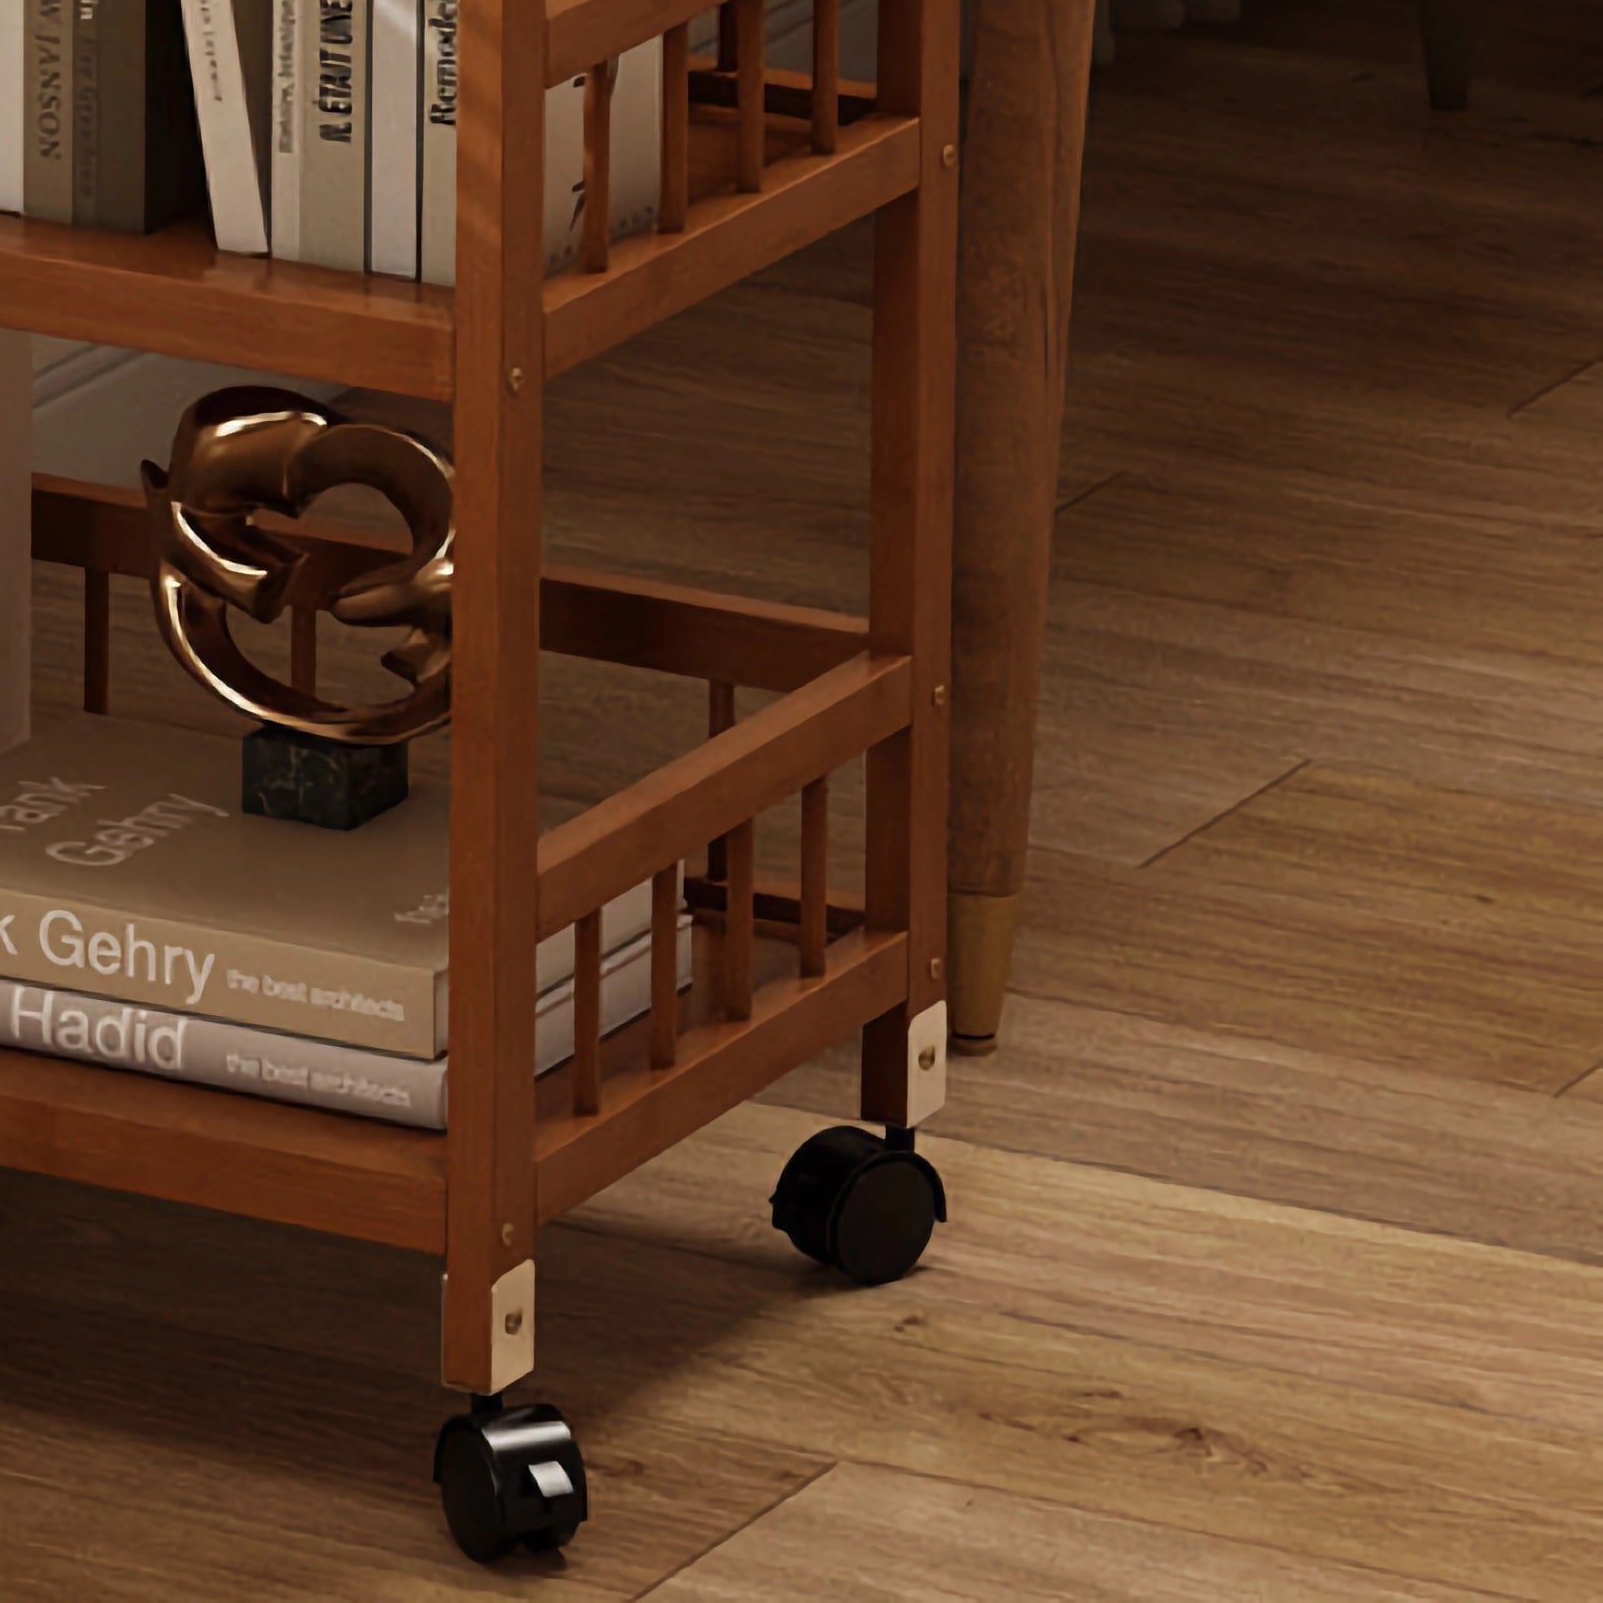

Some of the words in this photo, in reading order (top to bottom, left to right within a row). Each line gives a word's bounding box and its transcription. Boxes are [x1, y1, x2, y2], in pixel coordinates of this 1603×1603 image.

[36, 34, 64, 162] JANSON
[45, 792, 231, 867] Gehry
[37, 907, 217, 1003] Gehry
[7, 982, 190, 1073] Hadid
